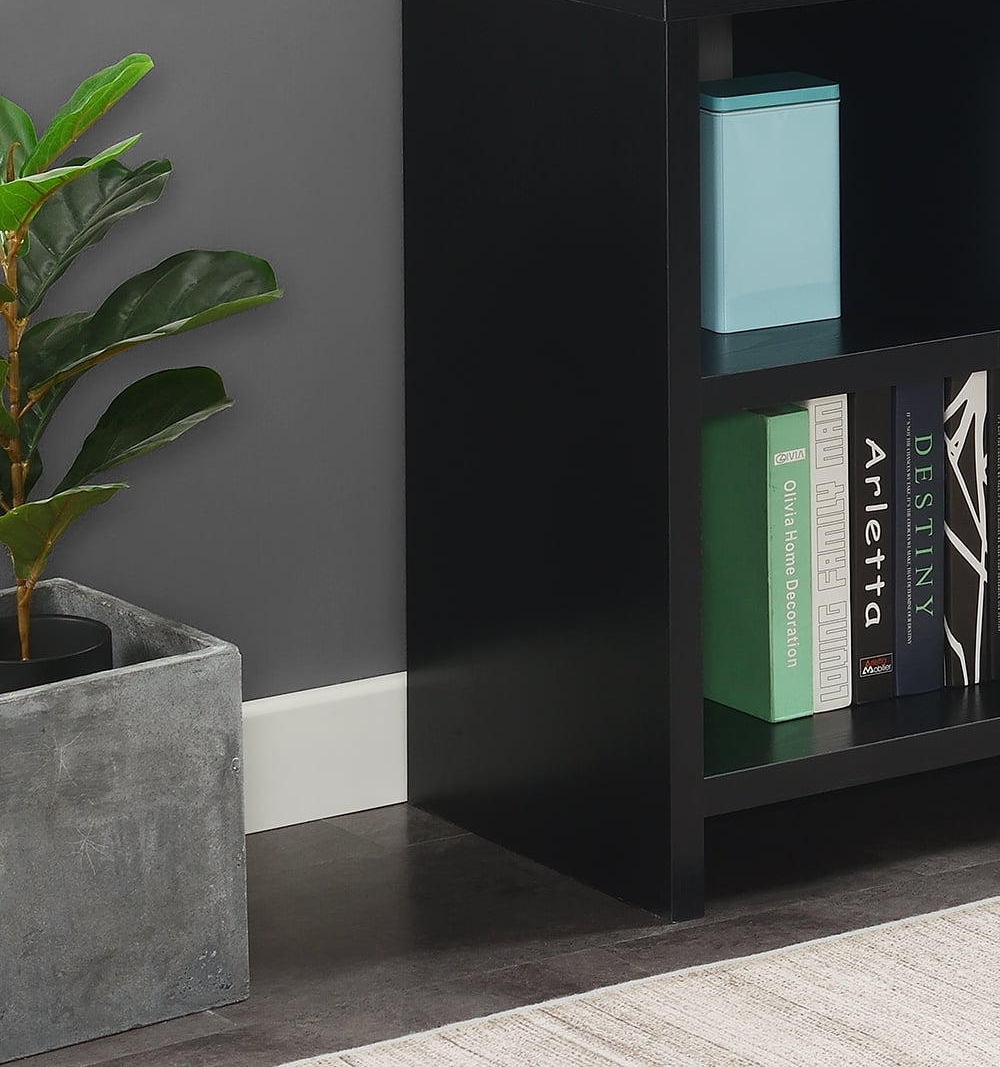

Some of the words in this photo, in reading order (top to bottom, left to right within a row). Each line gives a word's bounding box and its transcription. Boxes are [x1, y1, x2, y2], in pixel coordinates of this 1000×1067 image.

[814, 400, 844, 470] MAN
[783, 480, 797, 527] Olivia
[815, 481, 847, 592] FAMILY
[864, 437, 888, 628] Arletta
[914, 432, 934, 617] DESTINY
[784, 530, 798, 576] Home
[785, 579, 800, 669] Decoration
[817, 600, 849, 703] LOVING
